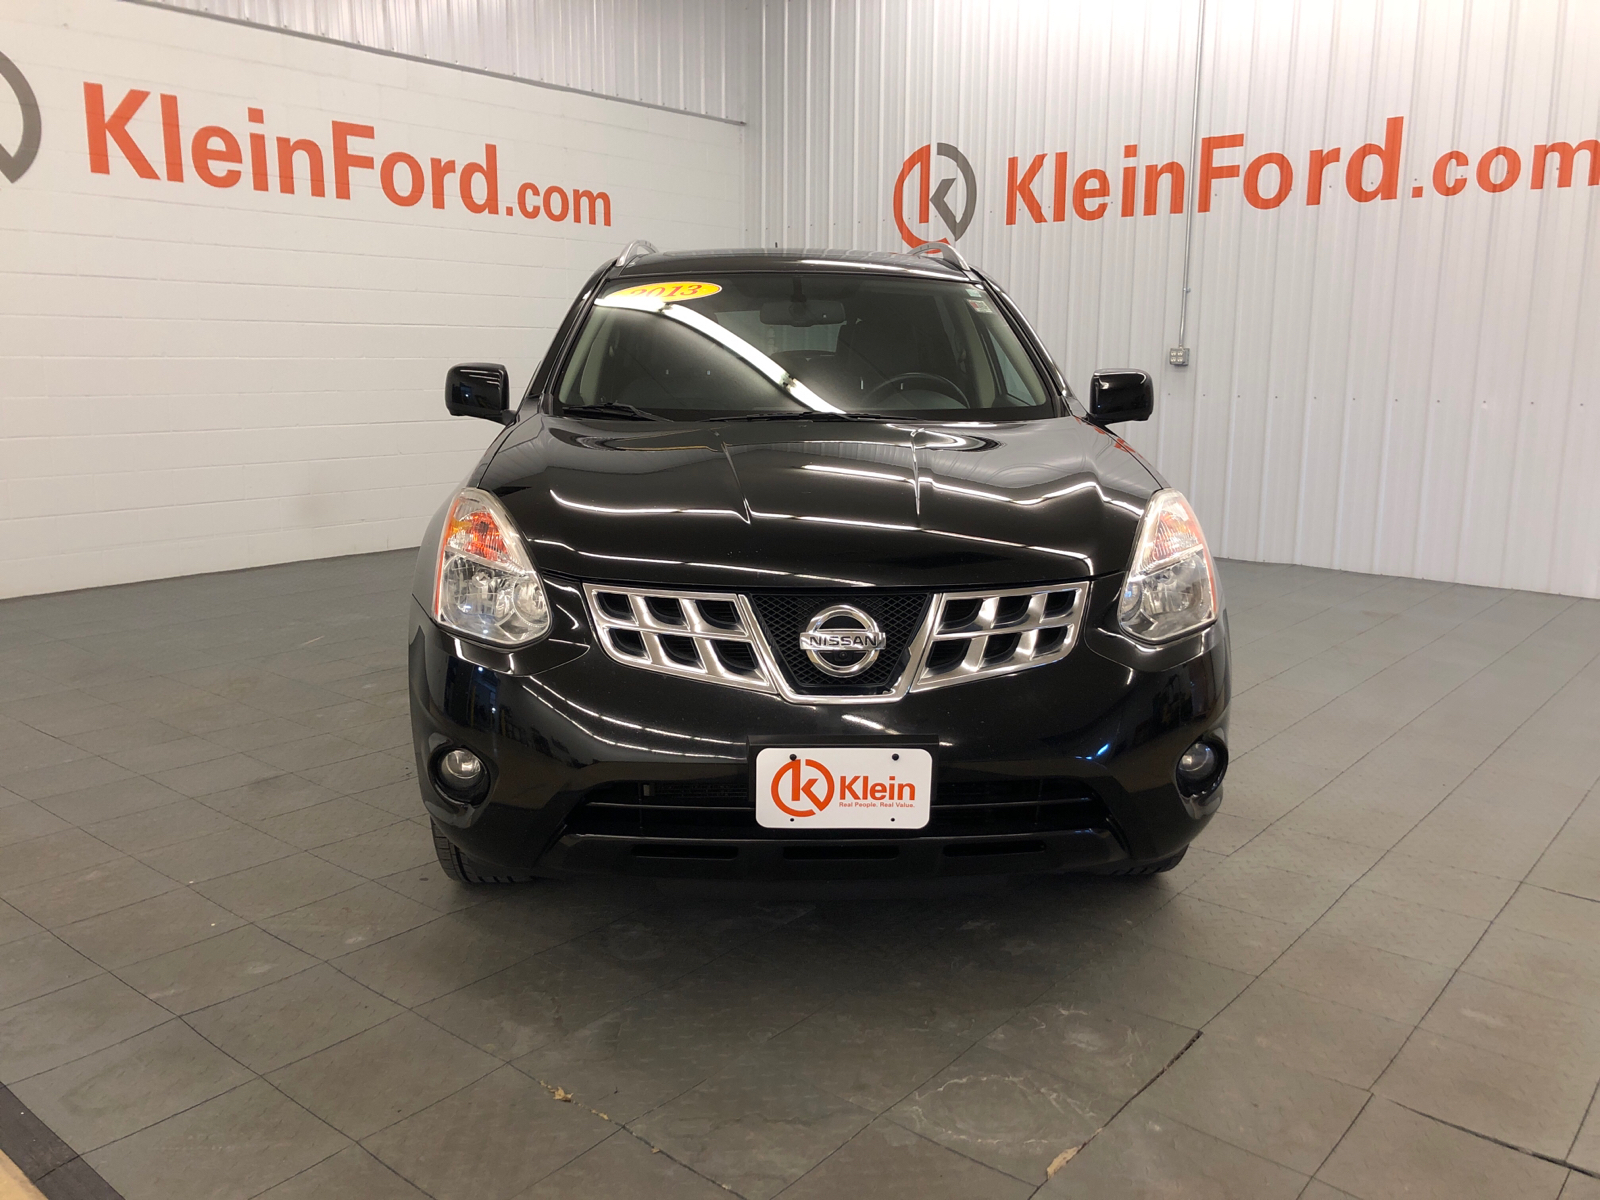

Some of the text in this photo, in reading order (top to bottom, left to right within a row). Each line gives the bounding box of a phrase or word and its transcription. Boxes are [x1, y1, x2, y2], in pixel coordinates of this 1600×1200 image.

[84, 81, 613, 227] KleinFord.com
[1005, 116, 1600, 226] KleinFord.com
[809, 635, 877, 646] NISSAN
[839, 775, 916, 801] Klein
[854, 801, 878, 809] People.
